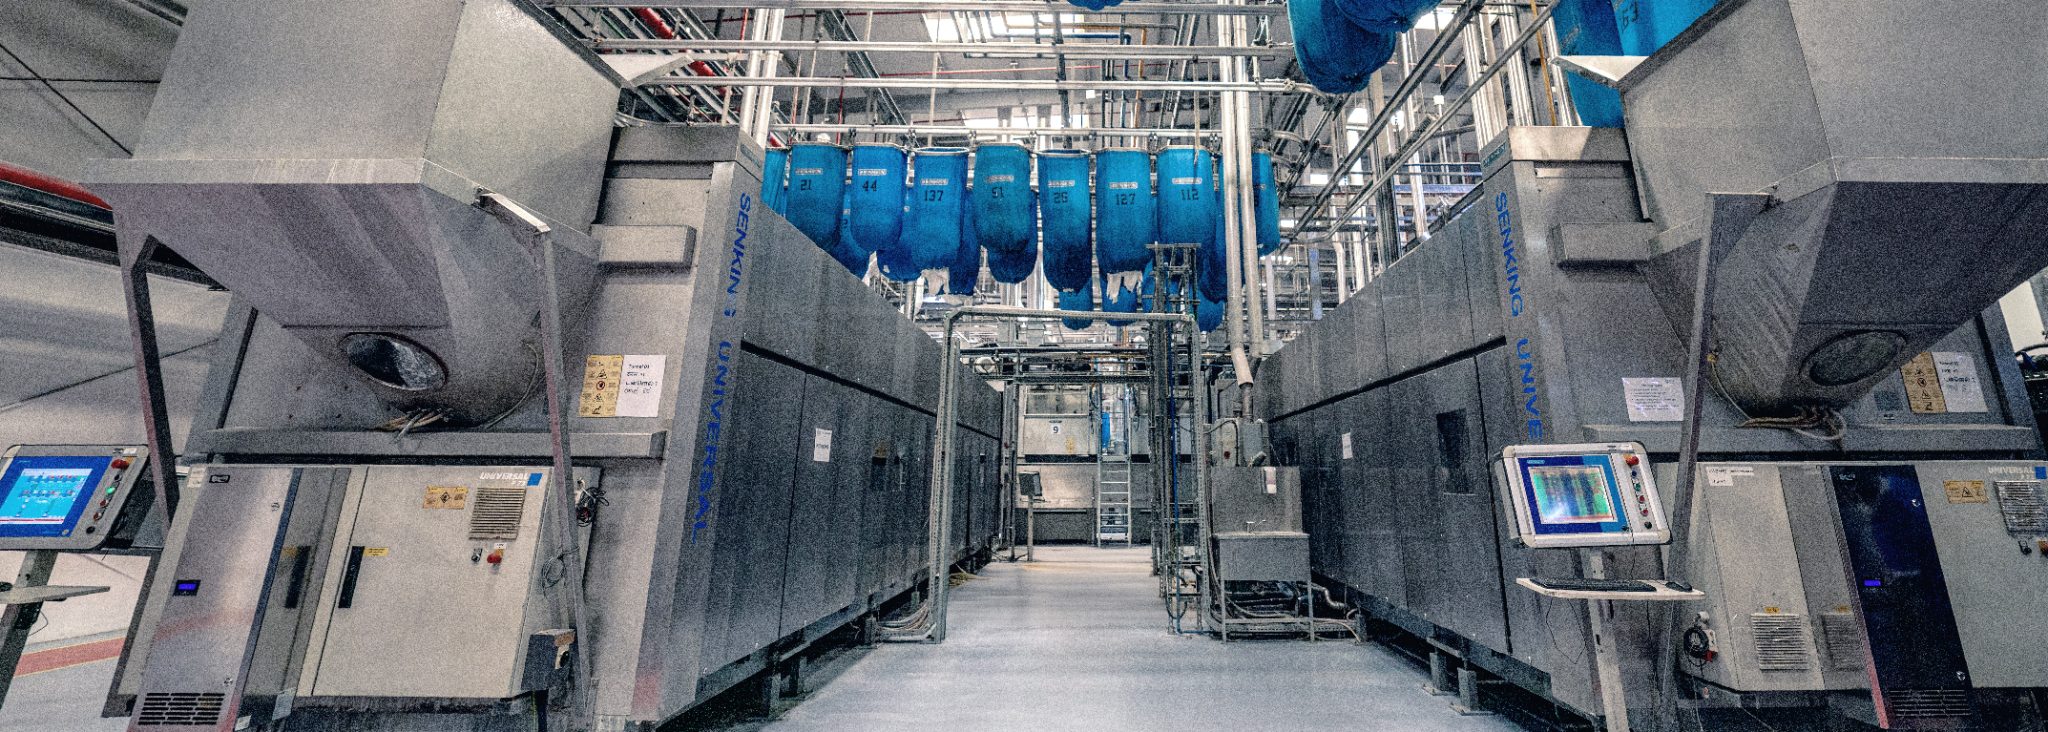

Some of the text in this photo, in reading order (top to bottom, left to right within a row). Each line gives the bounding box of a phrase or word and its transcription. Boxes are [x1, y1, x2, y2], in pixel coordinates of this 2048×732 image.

[800, 179, 812, 191] 21
[862, 180, 877, 192] 44
[924, 190, 944, 202] 137
[1115, 193, 1136, 205] 127
[1181, 188, 1199, 201] 112
[1495, 192, 1523, 317] SENKING
[1053, 426, 1059, 434] 9
[692, 341, 732, 544] UNIVERSAL
[480, 472, 528, 480] UNIVERSAL
